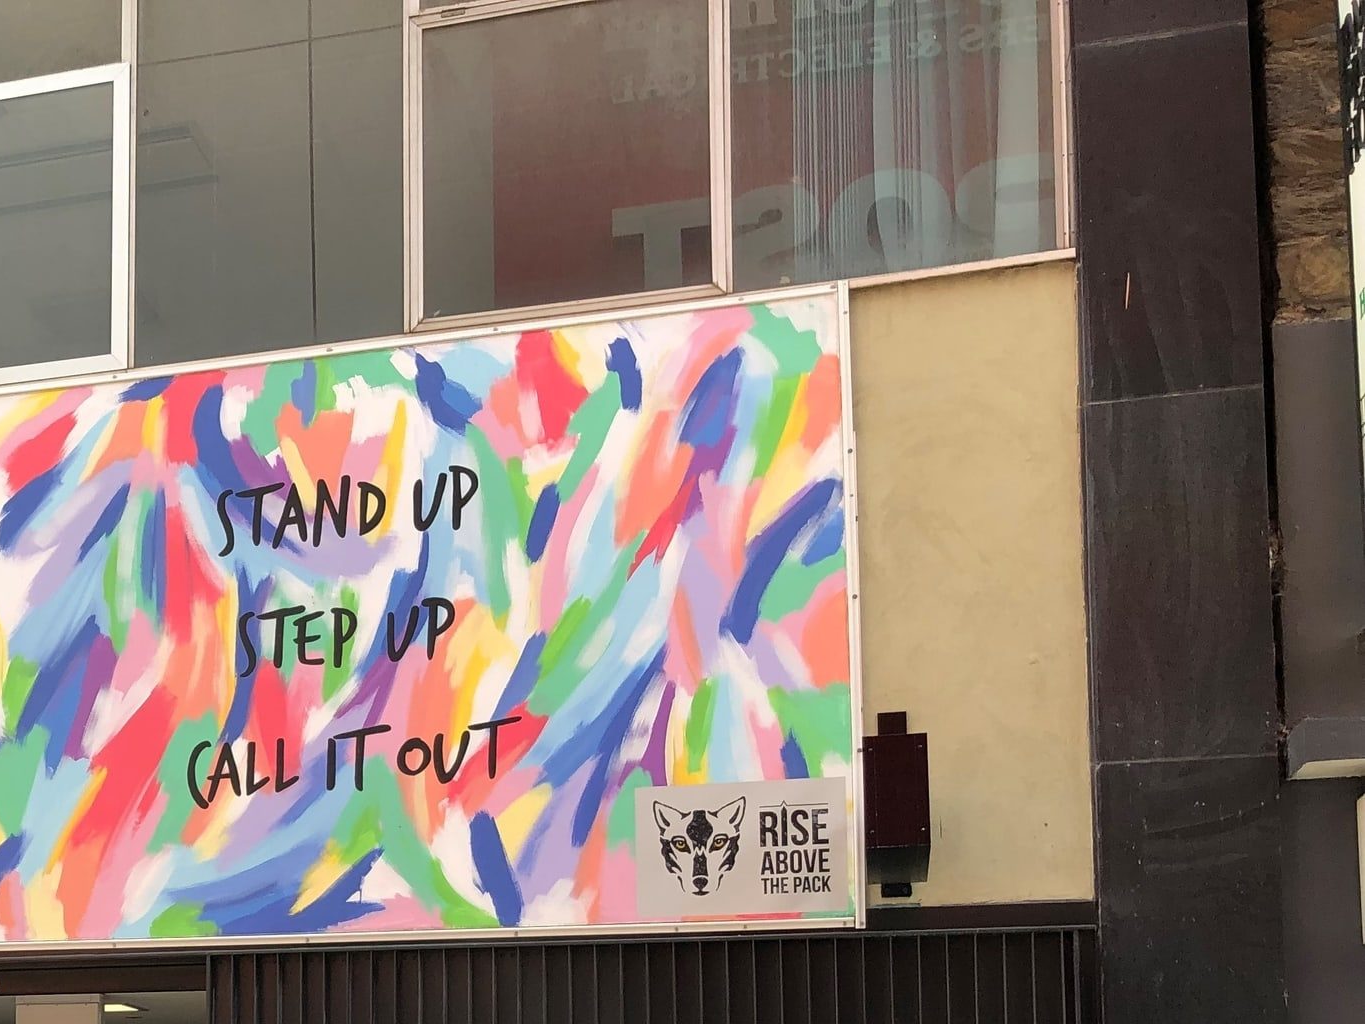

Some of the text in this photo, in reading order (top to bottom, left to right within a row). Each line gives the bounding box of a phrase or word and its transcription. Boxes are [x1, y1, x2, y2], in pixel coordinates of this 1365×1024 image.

[217, 464, 479, 557] STAND UP
[239, 596, 456, 677] STEP UP
[186, 715, 523, 810] CALL IT OUT
[758, 805, 830, 847] RISE
[760, 848, 831, 875] ABOVE
[761, 875, 832, 894] THE PACK
